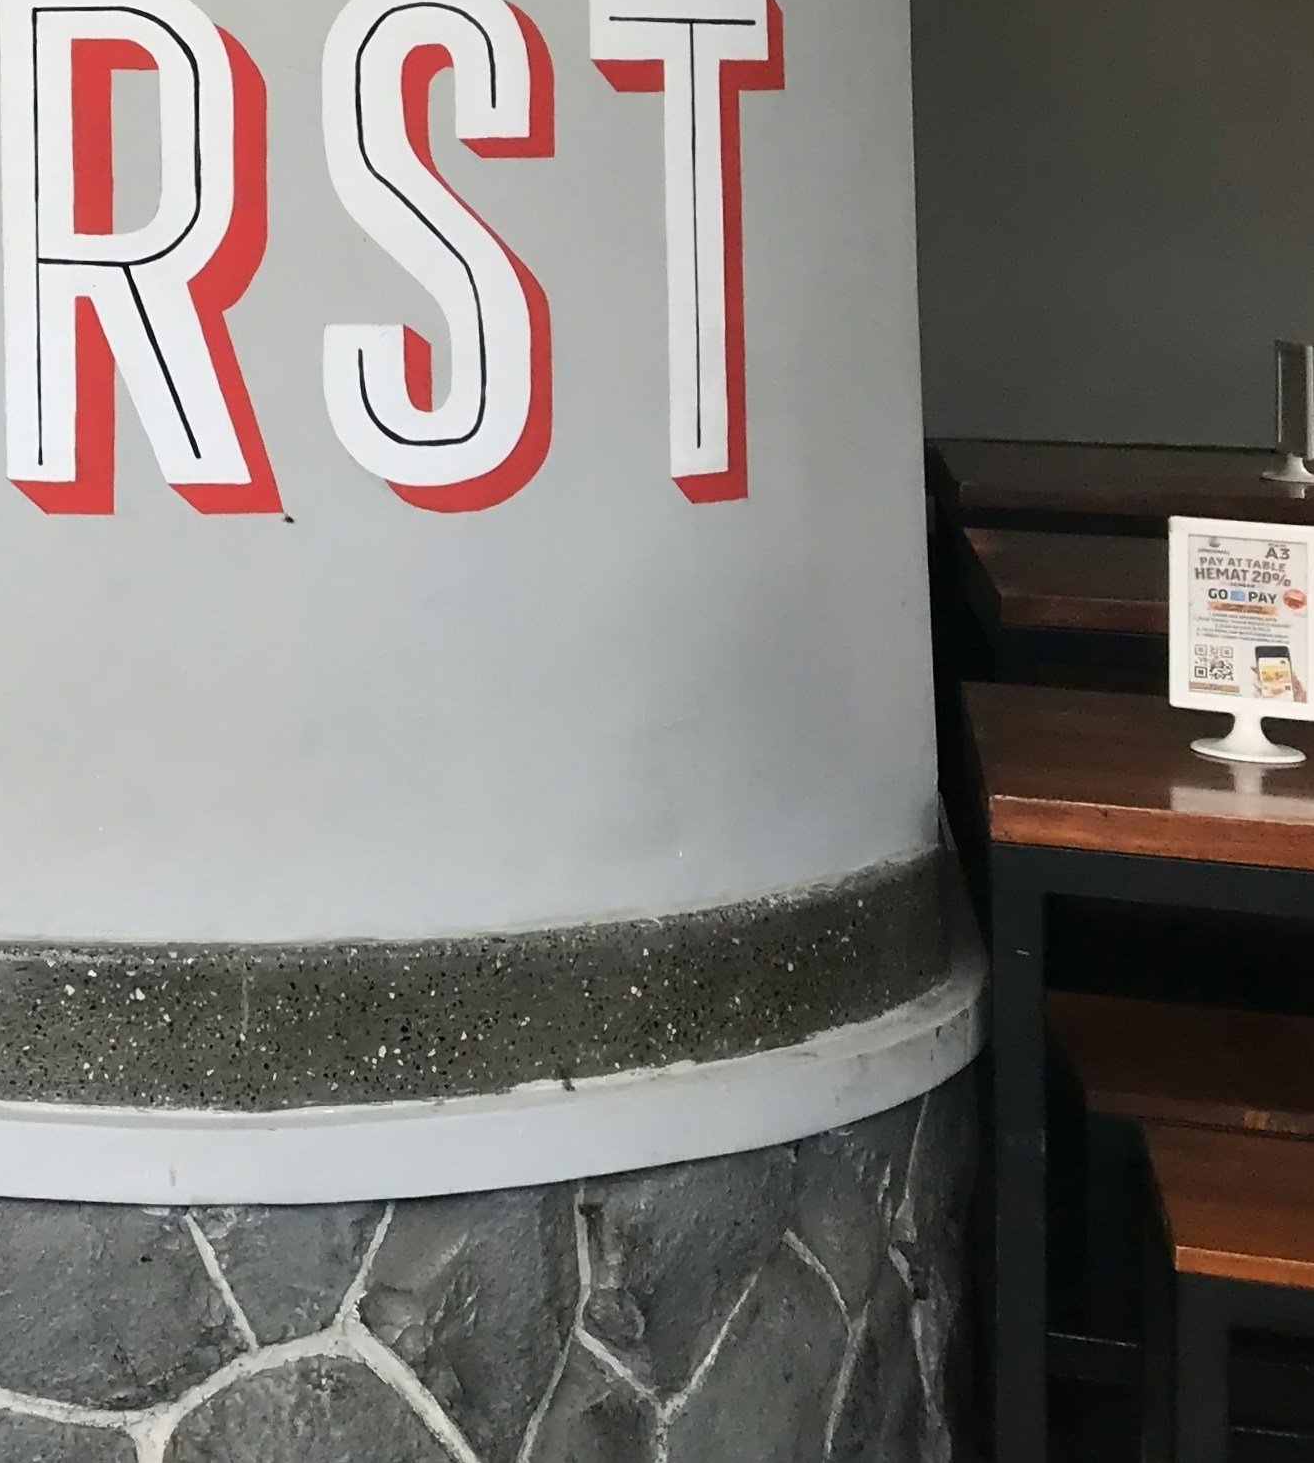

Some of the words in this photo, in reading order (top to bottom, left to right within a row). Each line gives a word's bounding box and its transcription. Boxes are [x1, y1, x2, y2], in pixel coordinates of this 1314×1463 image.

[1265, 546, 1290, 560] A3
[1199, 556, 1224, 567] PAY
[1227, 557, 1243, 568] AT
[1245, 558, 1287, 573] TABLE
[1194, 567, 1249, 581] HEMAT
[1251, 569, 1292, 587] 20%
[1208, 587, 1229, 600] GO
[1248, 591, 1277, 604] PAY
